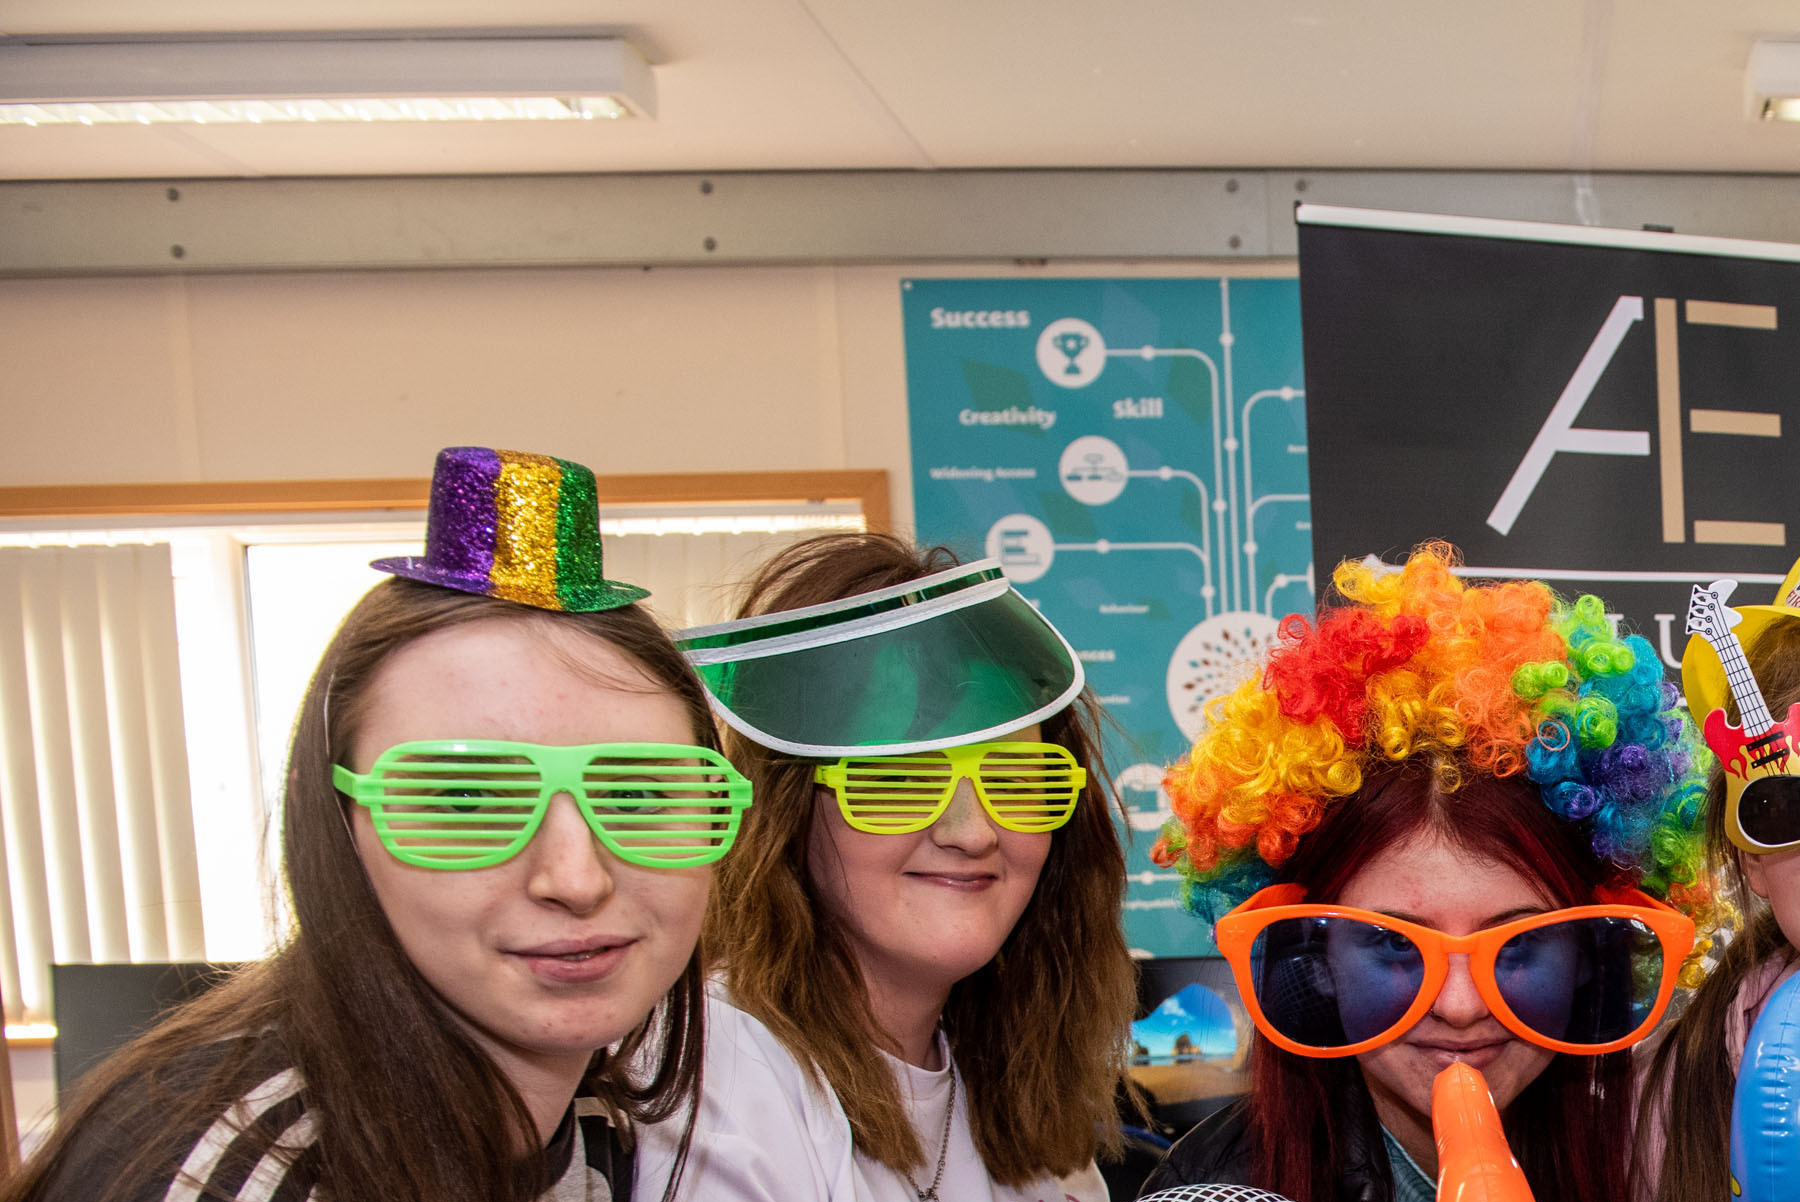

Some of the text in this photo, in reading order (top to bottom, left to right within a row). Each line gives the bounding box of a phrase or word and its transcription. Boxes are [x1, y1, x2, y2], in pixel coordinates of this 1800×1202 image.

[930, 307, 1030, 328] Success
[959, 406, 1056, 430] Creativity
[1112, 397, 1163, 418] Skill
